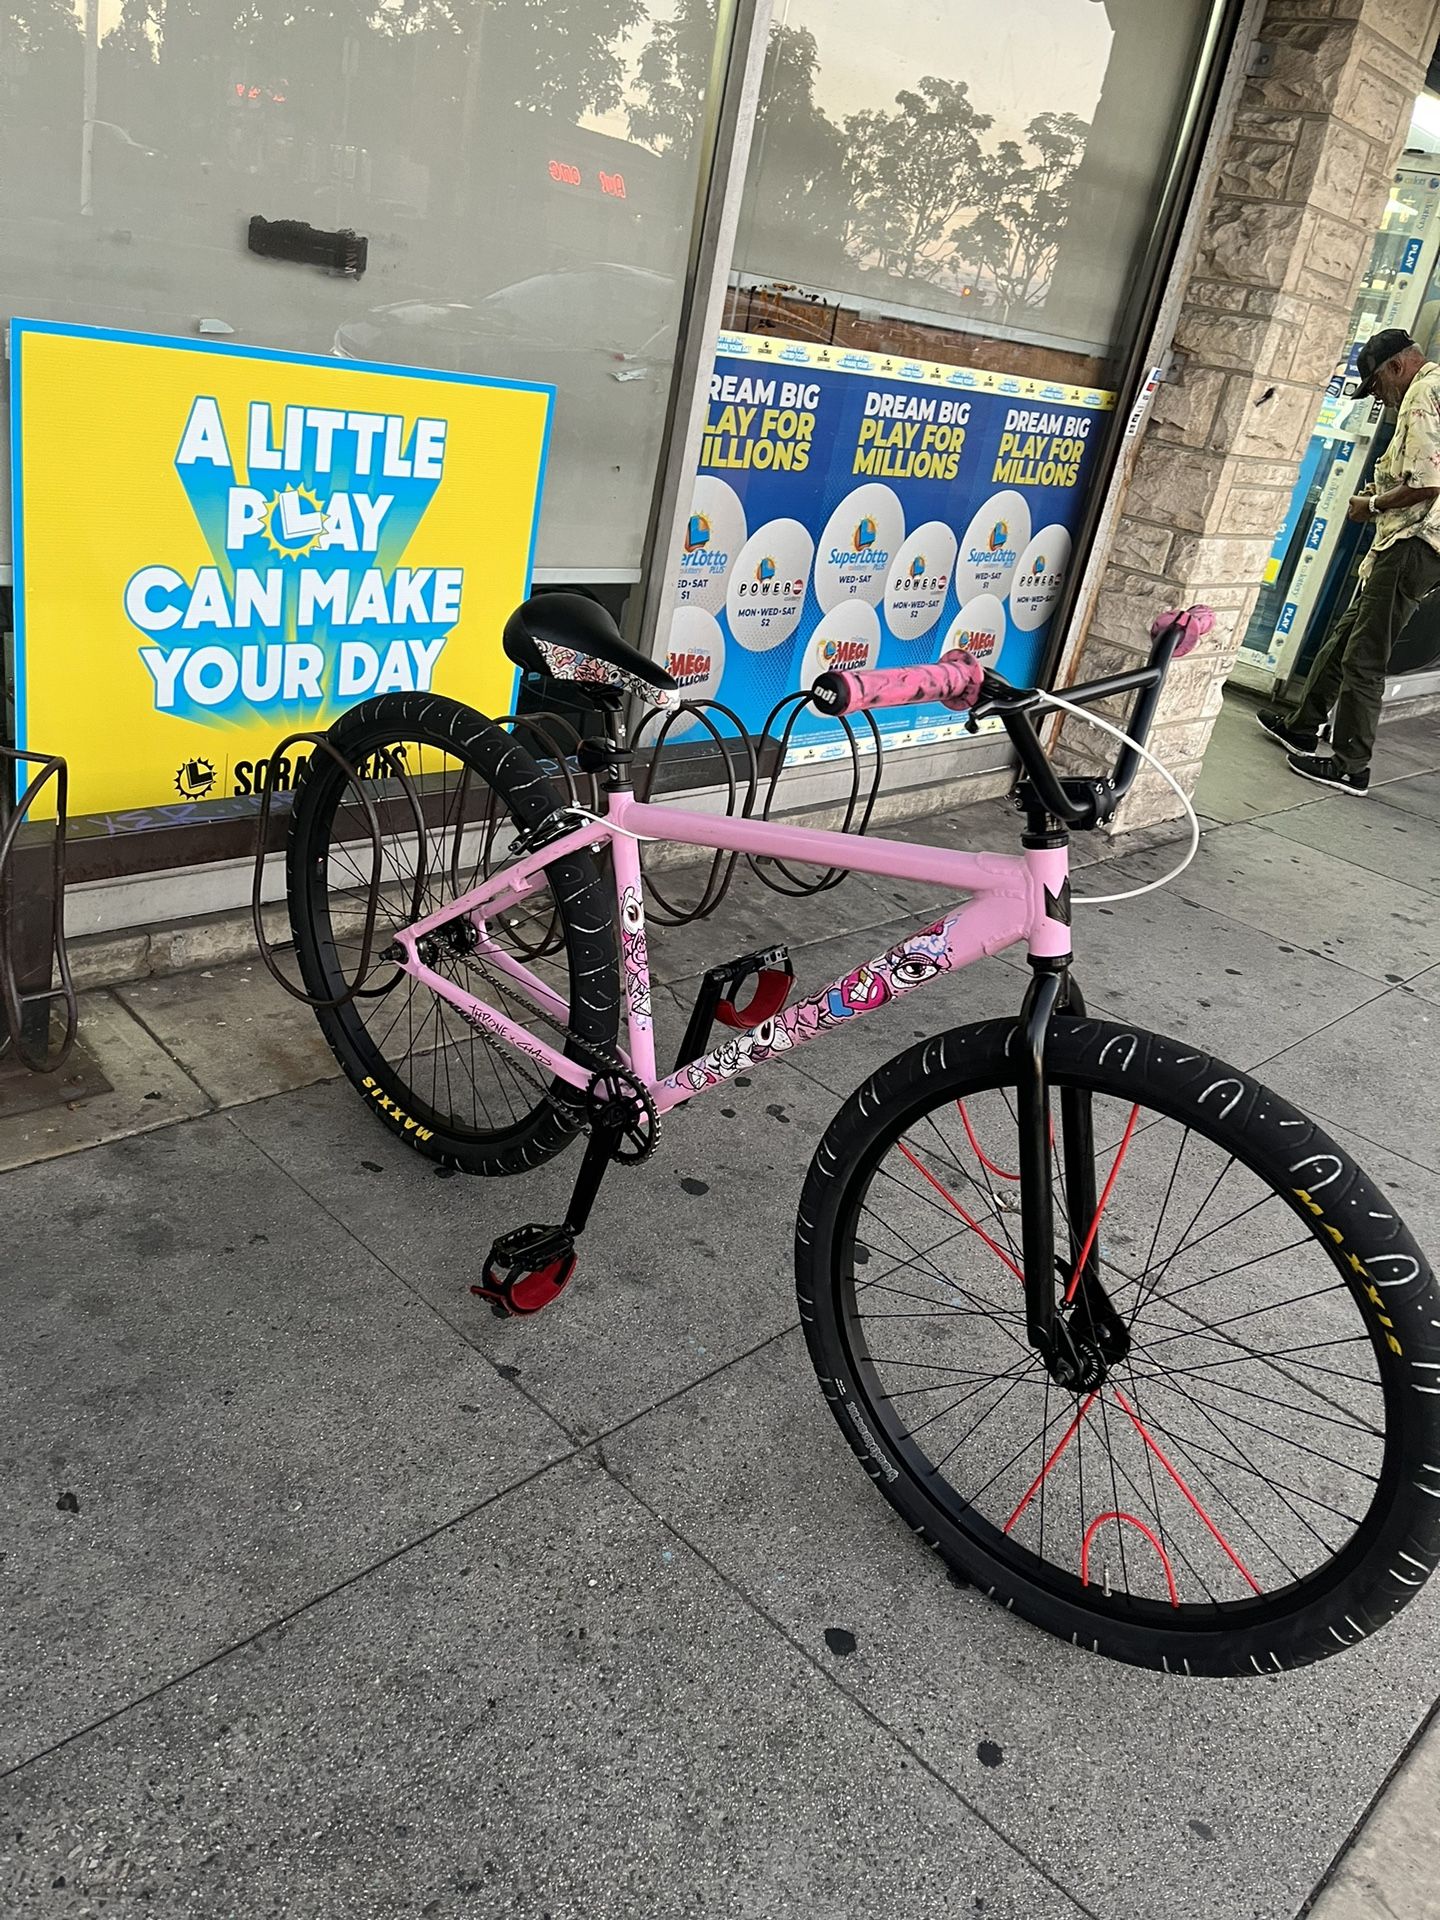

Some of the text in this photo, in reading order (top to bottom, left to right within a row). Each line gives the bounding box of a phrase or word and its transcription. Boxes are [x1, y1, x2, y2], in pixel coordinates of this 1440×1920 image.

[1405, 243, 1420, 270] PLAY
[708, 373, 821, 410] REAM BIG
[703, 403, 816, 442] LAY FOR
[864, 391, 972, 426] DREAM BIG
[1004, 408, 1092, 439] DREAM BIG
[175, 397, 447, 479] A LITTLE
[858, 418, 966, 453] PLAY FOR
[998, 432, 1085, 463] PLAY FOR
[701, 436, 811, 472] ILLIONS
[852, 447, 960, 480] MILLIONS
[992, 458, 1080, 487] MILLIONS
[226, 485, 395, 553] PLAY
[1311, 521, 1325, 547] PLAY
[681, 549, 728, 567] erLotto
[828, 547, 889, 569] SuperLotto
[125, 565, 463, 631] CAN MAKE
[681, 591, 691, 600] $1
[738, 581, 792, 597] POWER
[895, 578, 938, 591] POWER
[760, 618, 771, 628] $2
[1280, 606, 1295, 631] PLAY
[668, 652, 711, 676] MEGA
[832, 640, 869, 663] MEGA
[140, 637, 447, 708] YOUR DAY
[677, 672, 710, 688] ILLIONS
[813, 685, 837, 704] odi
[362, 1076, 435, 1141] MAXXIS
[1288, 1180, 1403, 1357] MAXXIS
